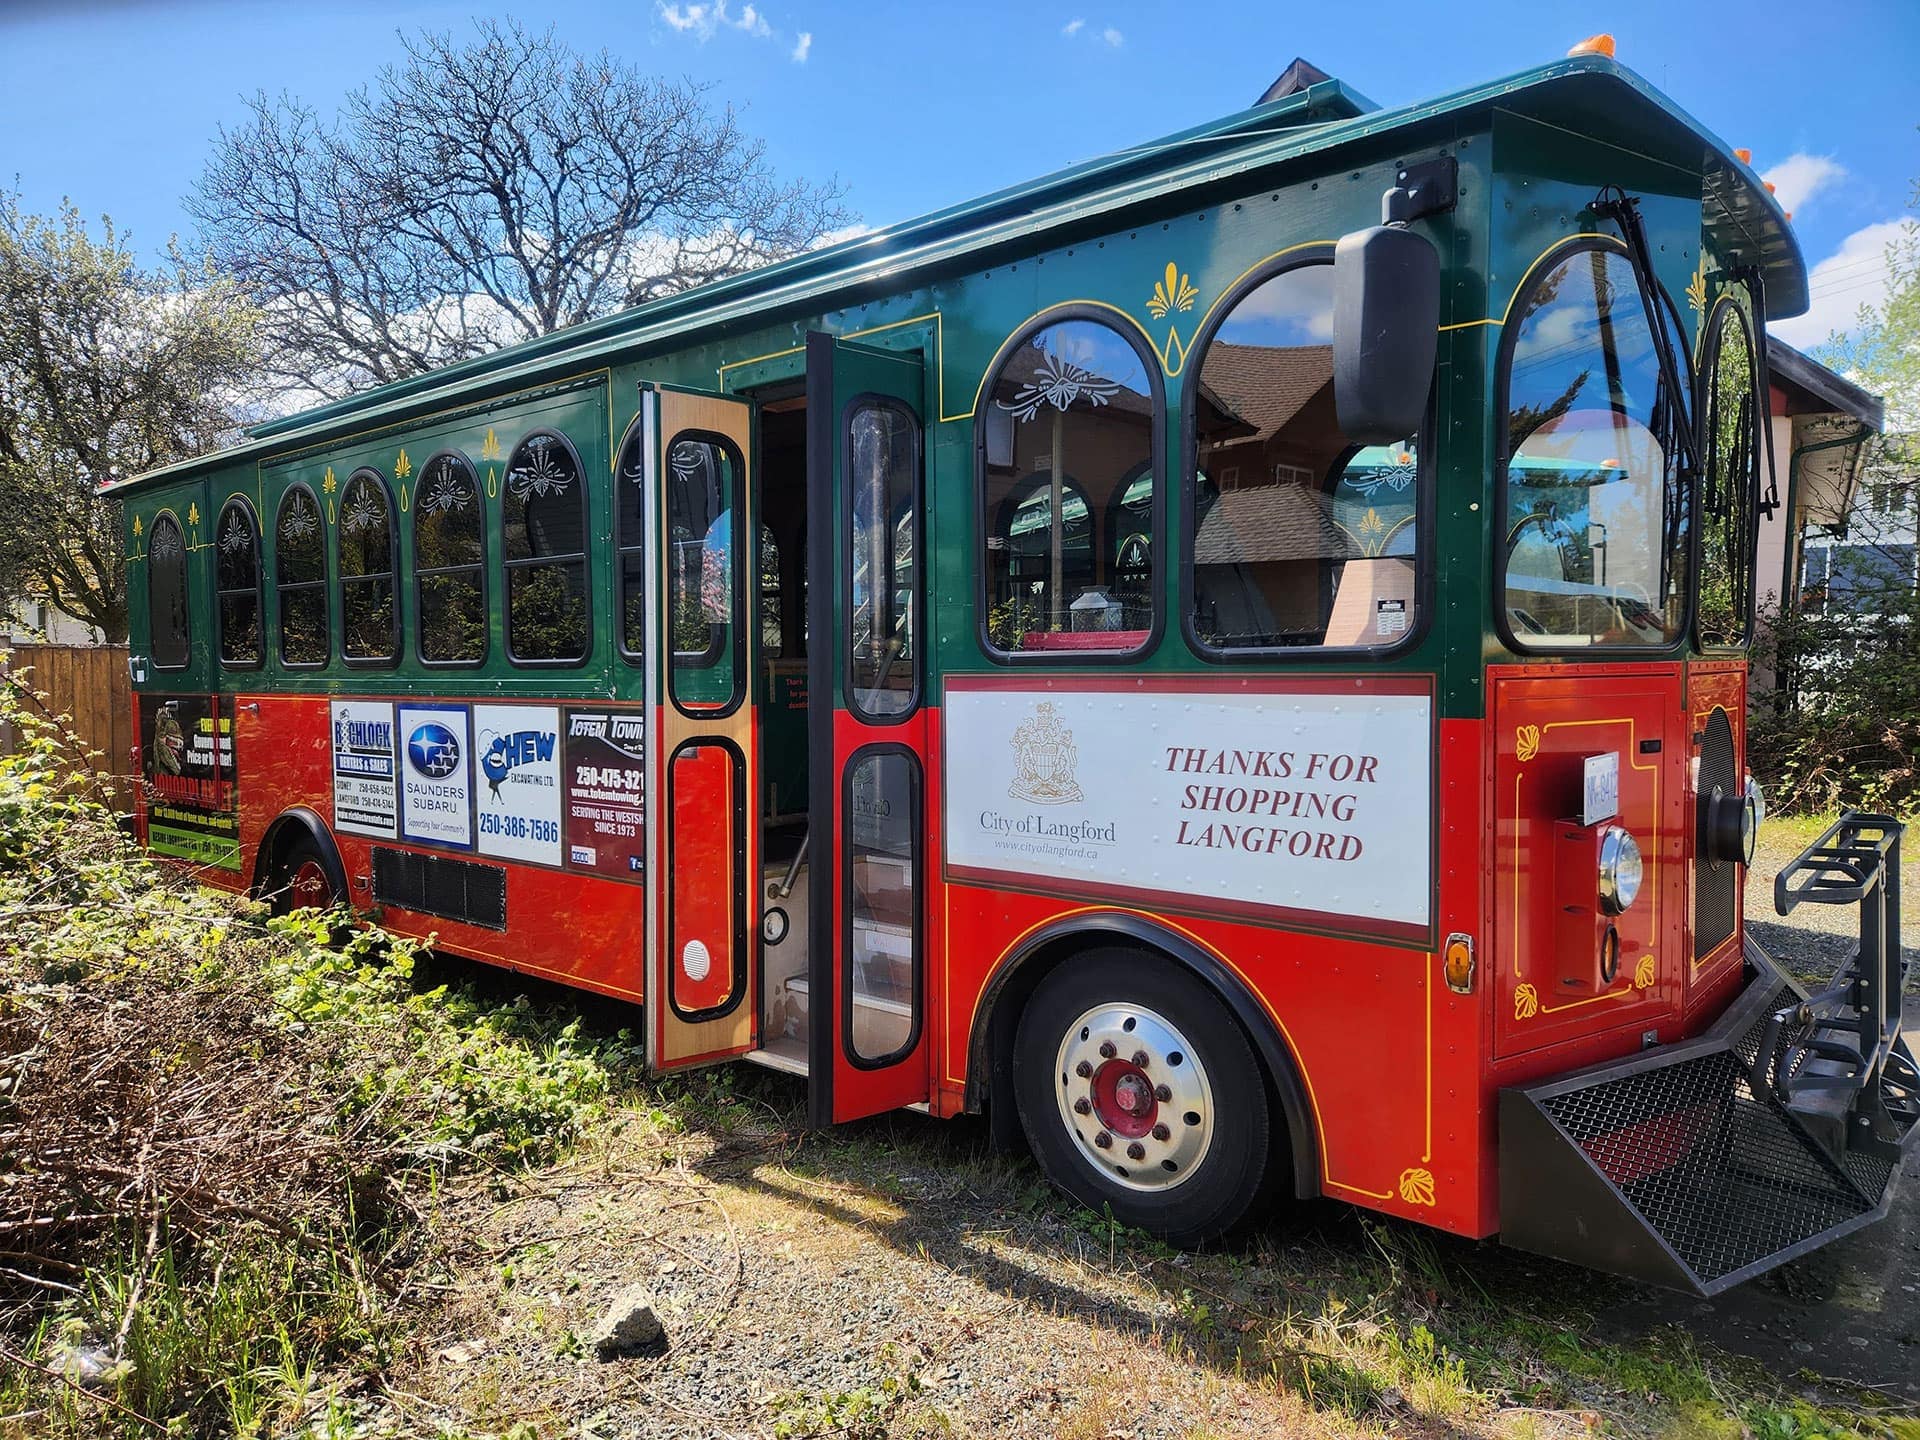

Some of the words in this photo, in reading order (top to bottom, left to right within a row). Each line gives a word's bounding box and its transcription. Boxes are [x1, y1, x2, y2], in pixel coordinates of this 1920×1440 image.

[363, 758, 369, 772] &
[369, 757, 389, 774] SALES
[480, 730, 556, 782] CHEW
[1165, 747, 1295, 779] THANKS
[1303, 752, 1379, 783] FOR
[510, 772, 543, 787] EXCAVATING
[576, 765, 643, 791] 250-475-321
[407, 782, 465, 800] SAUNDERS
[413, 797, 457, 814] SUBARU
[1181, 784, 1357, 822] SHOPPING
[571, 806, 600, 820] SERVING
[601, 808, 615, 822] THE
[615, 811, 644, 825] WESTSH
[407, 817, 431, 832] Supporting
[440, 822, 466, 837] Community
[479, 812, 559, 843] 250-386-7586
[594, 821, 616, 835] SINCE
[617, 824, 636, 837] 1973
[980, 810, 1013, 836] City
[1016, 814, 1034, 834] of
[1037, 815, 1116, 844] Langford
[994, 838, 1099, 860] www.cityoflangford.ca
[1176, 820, 1364, 862] LANGFORD
